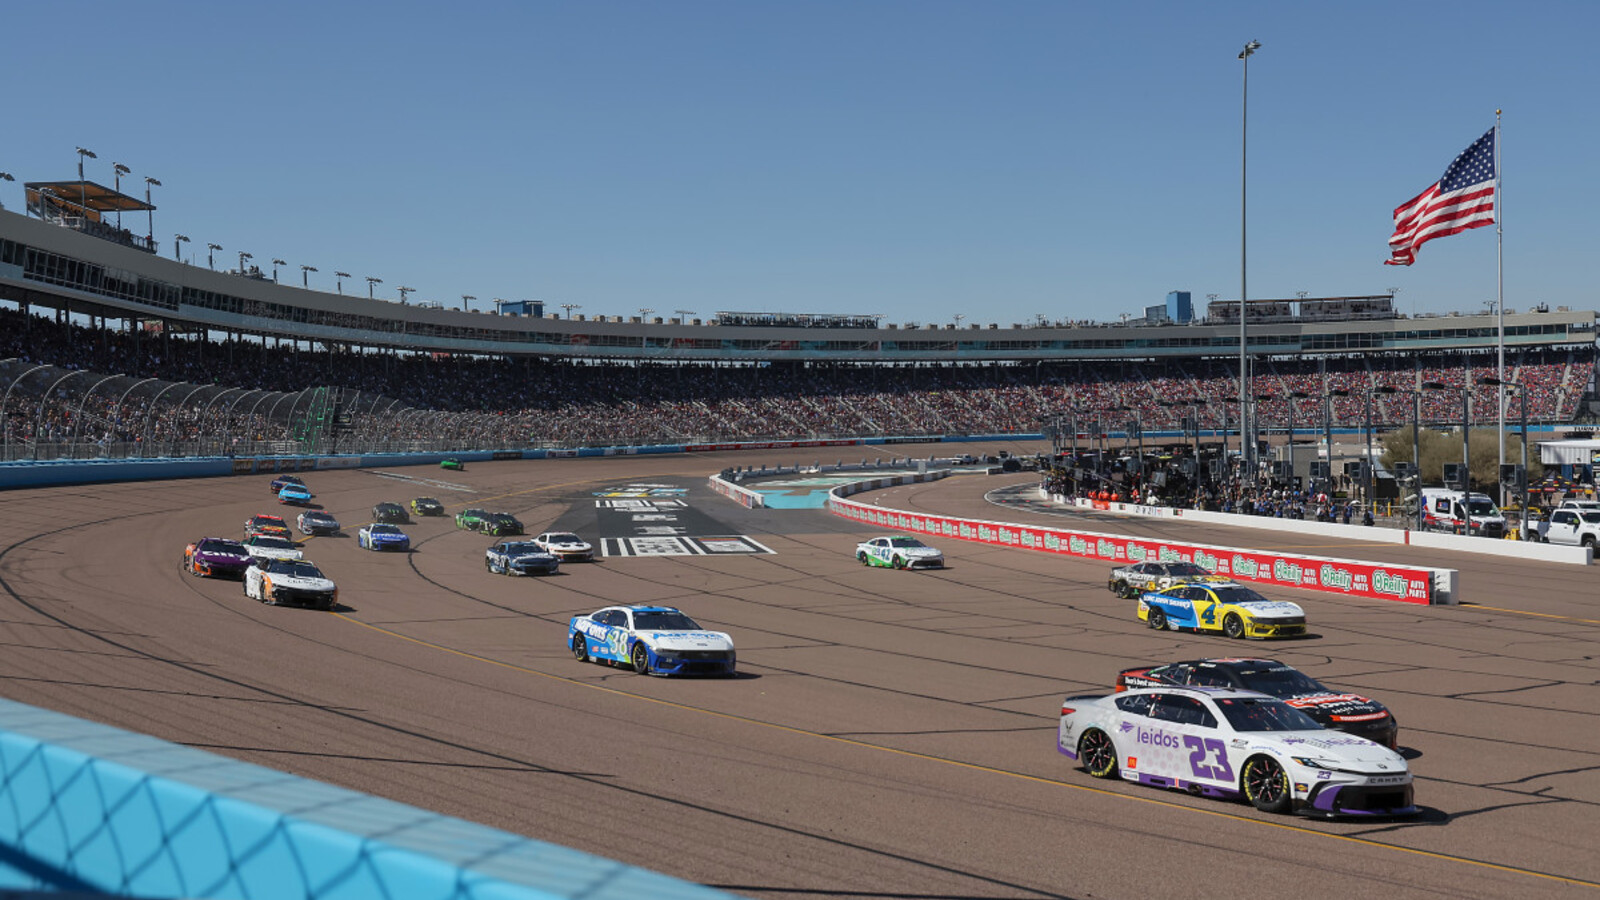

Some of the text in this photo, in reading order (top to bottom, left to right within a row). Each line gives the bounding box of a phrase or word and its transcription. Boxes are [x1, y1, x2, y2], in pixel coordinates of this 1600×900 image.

[1232, 554, 1258, 579] O'Reilly
[1274, 559, 1302, 585] O'Reilly
[1304, 568, 1316, 576] AUTO
[1259, 571, 1271, 579] PARTS
[1303, 576, 1317, 585] PARTS
[1320, 564, 1352, 591] O'Reilly
[1354, 574, 1367, 583] AUTO
[1353, 583, 1368, 591] PARTS
[1372, 570, 1408, 598] O'Reilly
[1410, 580, 1425, 589] AUTO
[1409, 589, 1426, 599] PARTS
[1201, 604, 1216, 624] 4
[610, 630, 628, 655] 38
[1137, 726, 1179, 748] leidos
[1183, 735, 1235, 782] 23
[1317, 771, 1332, 780] 23
